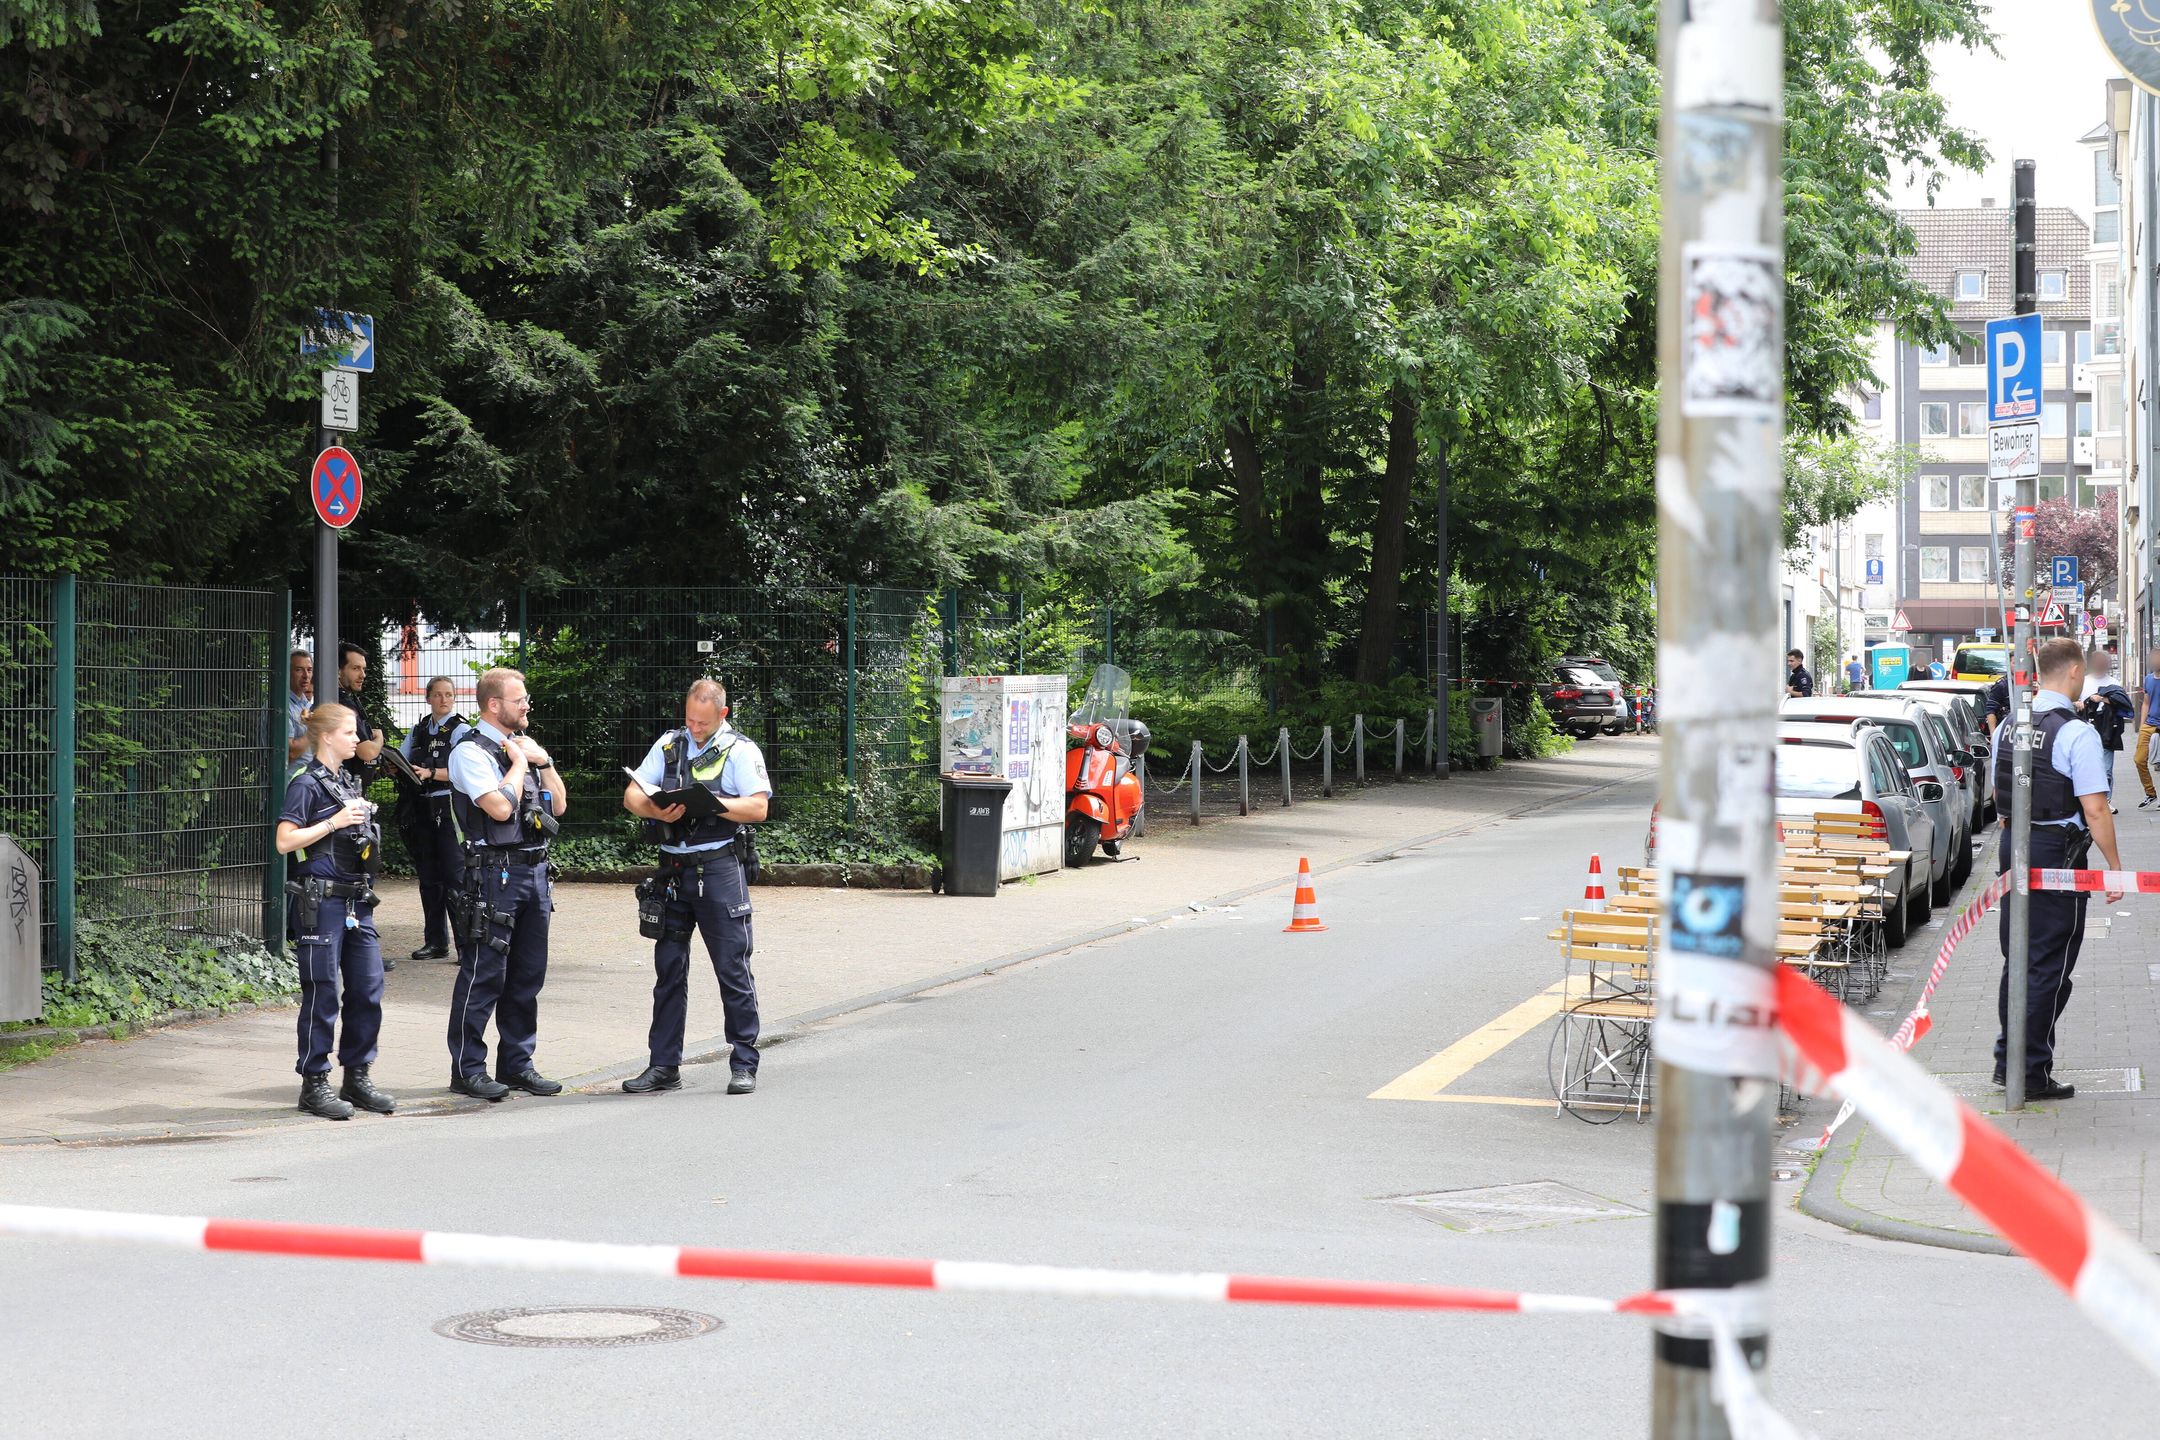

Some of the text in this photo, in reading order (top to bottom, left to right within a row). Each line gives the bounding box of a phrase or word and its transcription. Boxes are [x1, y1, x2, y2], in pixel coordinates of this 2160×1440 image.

[1996, 331, 2026, 404] P
[1994, 430, 2033, 451] Bewohner
[2056, 560, 2070, 583] P
